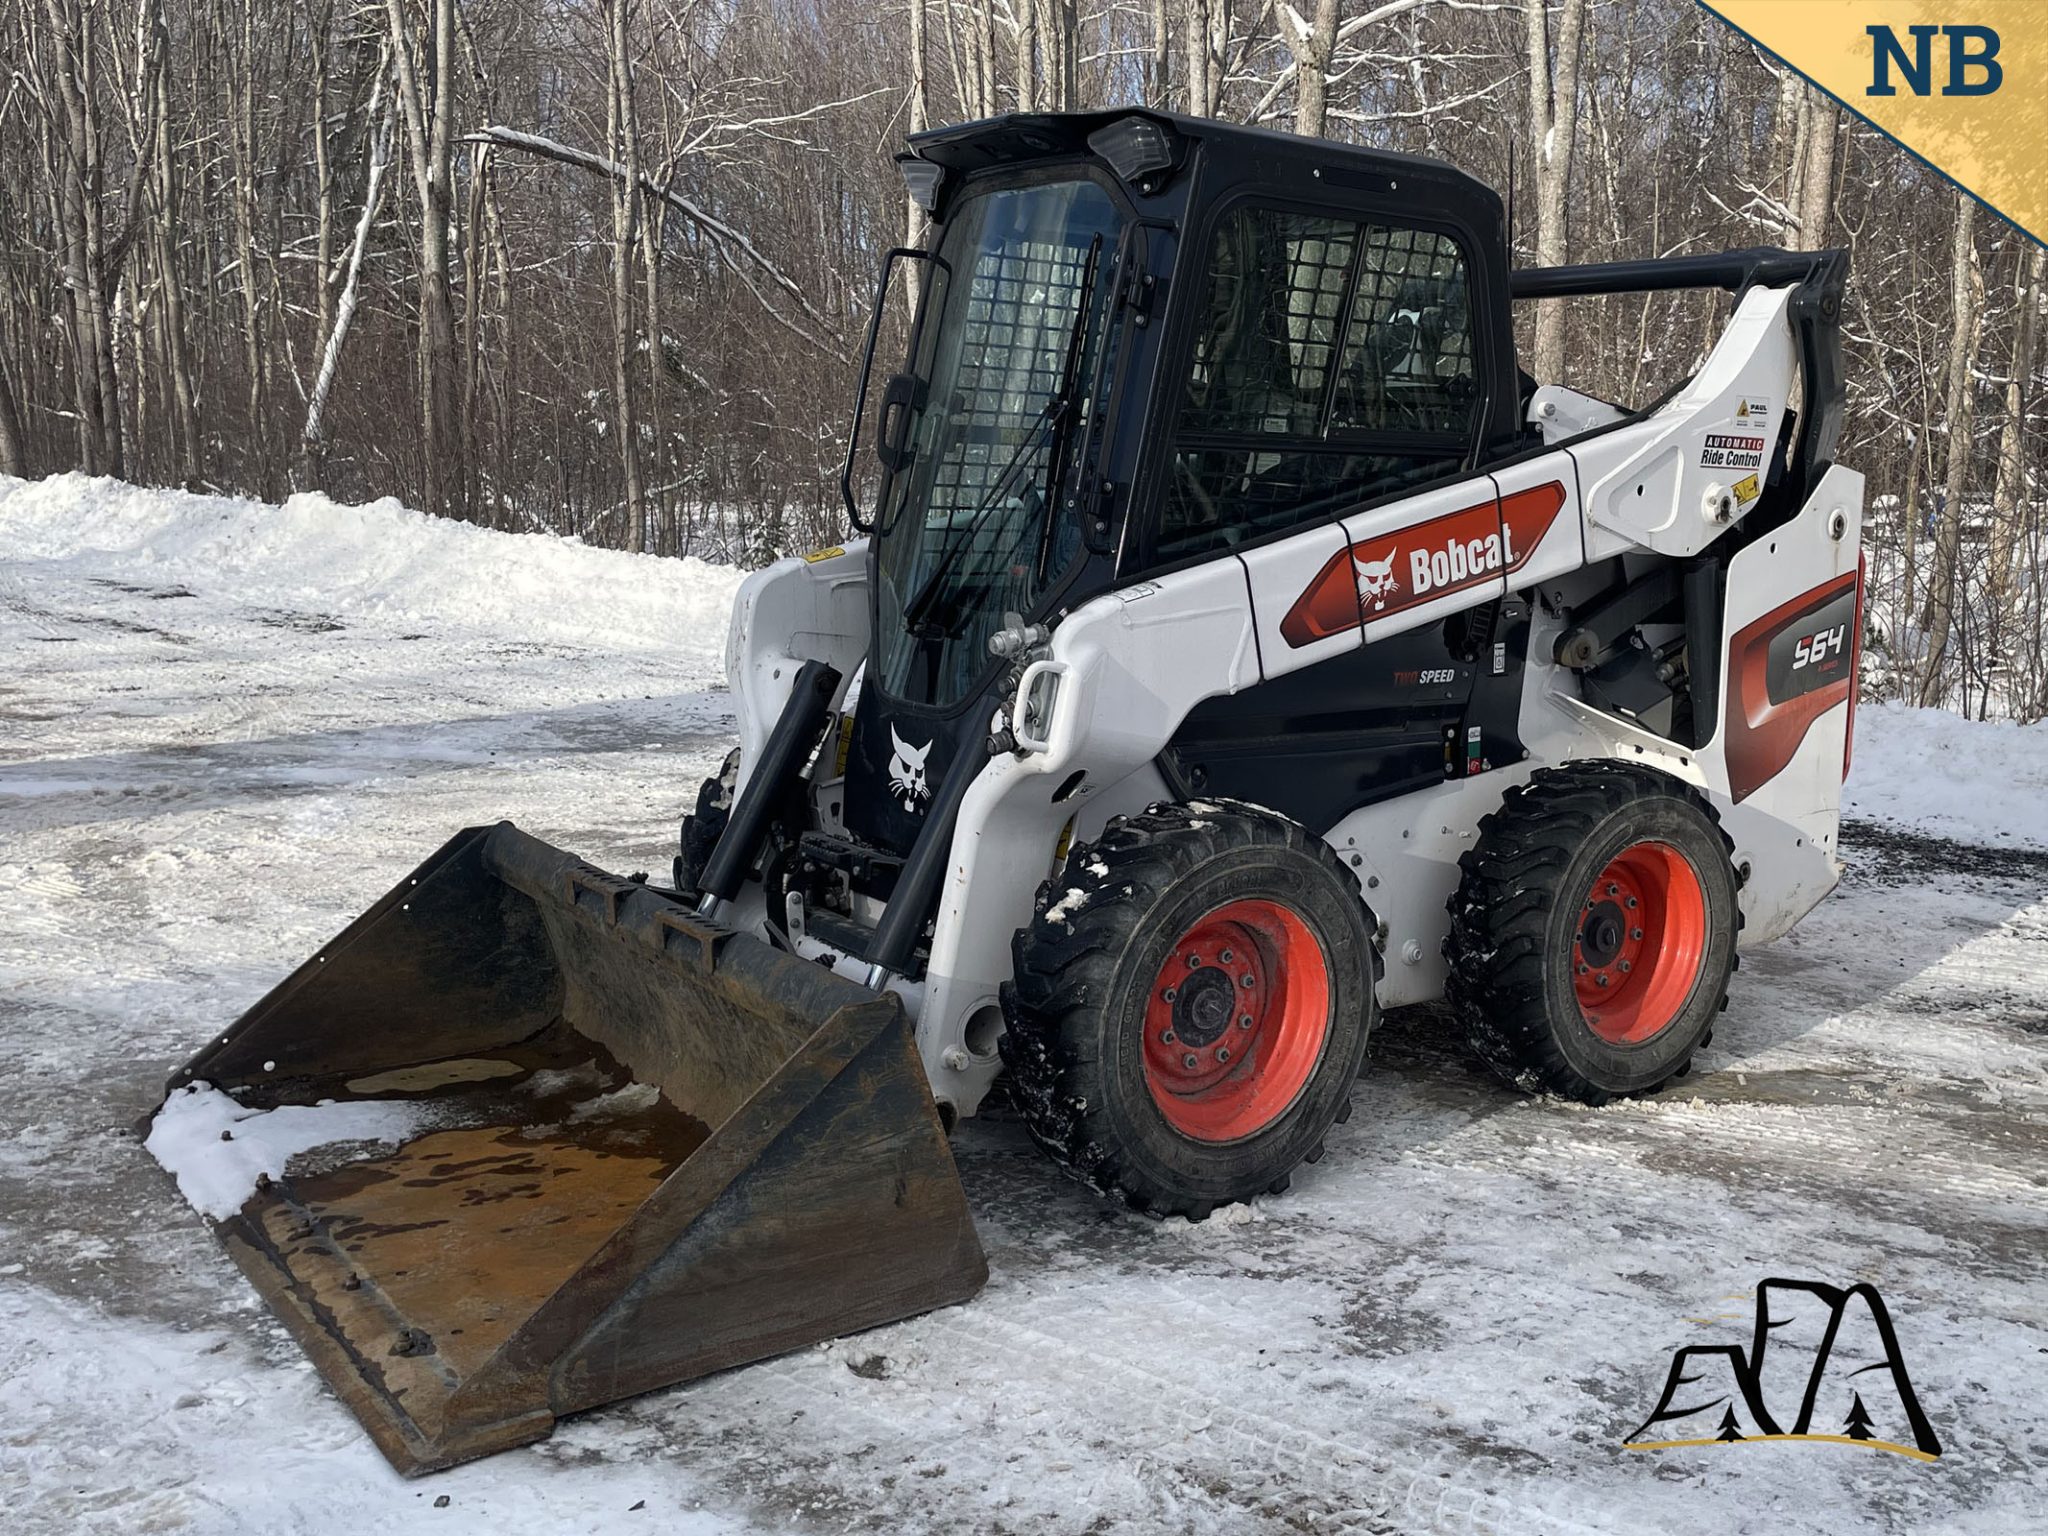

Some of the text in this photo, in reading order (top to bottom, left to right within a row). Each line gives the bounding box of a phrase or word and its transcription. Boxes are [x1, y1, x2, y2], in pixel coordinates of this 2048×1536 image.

[1706, 436, 1763, 450] AUTOMATIC
[1701, 449, 1762, 467] Ride Control
[1409, 523, 1514, 595] Bobcat
[1792, 624, 1845, 670] S64
[1394, 669, 1455, 686] TWO SPEED
